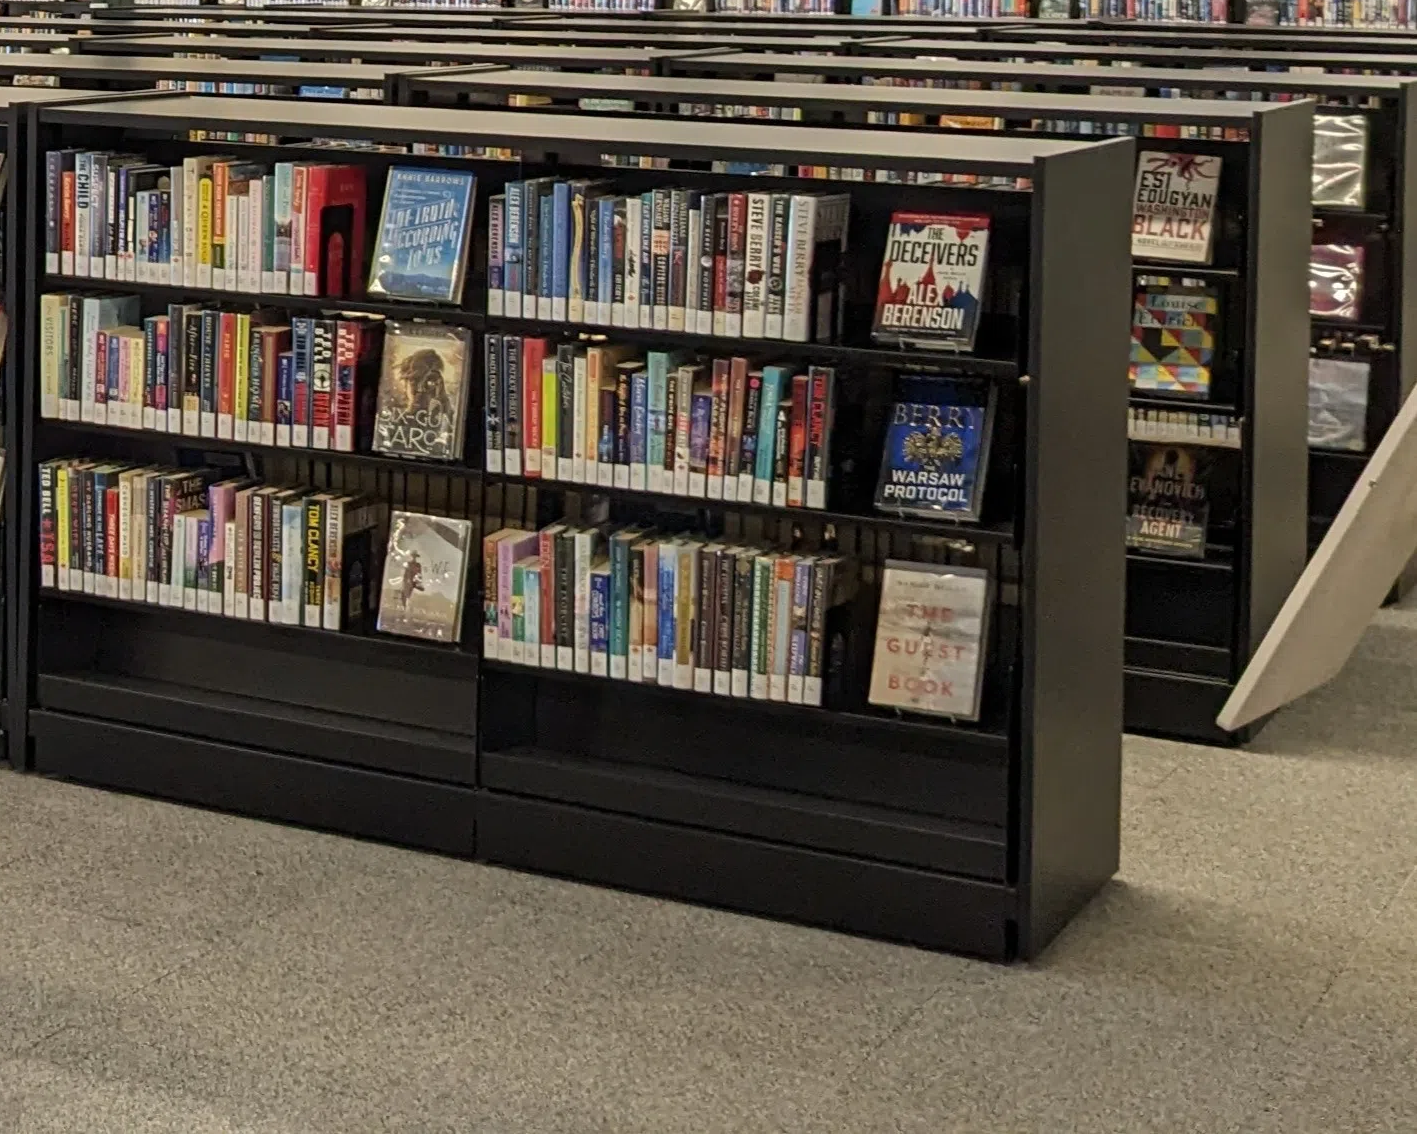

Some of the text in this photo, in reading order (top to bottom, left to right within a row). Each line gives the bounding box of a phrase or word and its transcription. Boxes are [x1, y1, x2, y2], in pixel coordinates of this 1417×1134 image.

[77, 173, 89, 209] CHILD
[1140, 170, 1172, 188] ESI
[1135, 203, 1210, 219] WASHINGTON
[1137, 188, 1212, 209] EDUGYAN
[508, 187, 520, 244] ALEX BERENSON
[1132, 214, 1207, 241] BLACK
[491, 205, 499, 259] ALEX BERENSON
[749, 199, 764, 268] STEVE BERRY
[794, 200, 810, 277] STEVE BERRY
[928, 227, 945, 240] THE
[891, 240, 979, 266] DECEIVERS
[906, 284, 944, 306] ALEX
[882, 303, 964, 330] BERENSON
[44, 316, 55, 356] VISITORS
[314, 328, 332, 362] TED BELL
[338, 328, 356, 363] TED BELL
[810, 401, 825, 447] CLANCY
[182, 477, 203, 493] THE
[892, 469, 966, 486] WARSAW
[42, 468, 52, 514] TED BELL
[884, 484, 968, 502] PROTOCOL
[307, 504, 320, 573] TOM CLANCY
[1140, 520, 1183, 538] AGENT
[907, 604, 954, 622] THE
[886, 637, 966, 660] GUEST
[888, 674, 954, 697] BOOK
